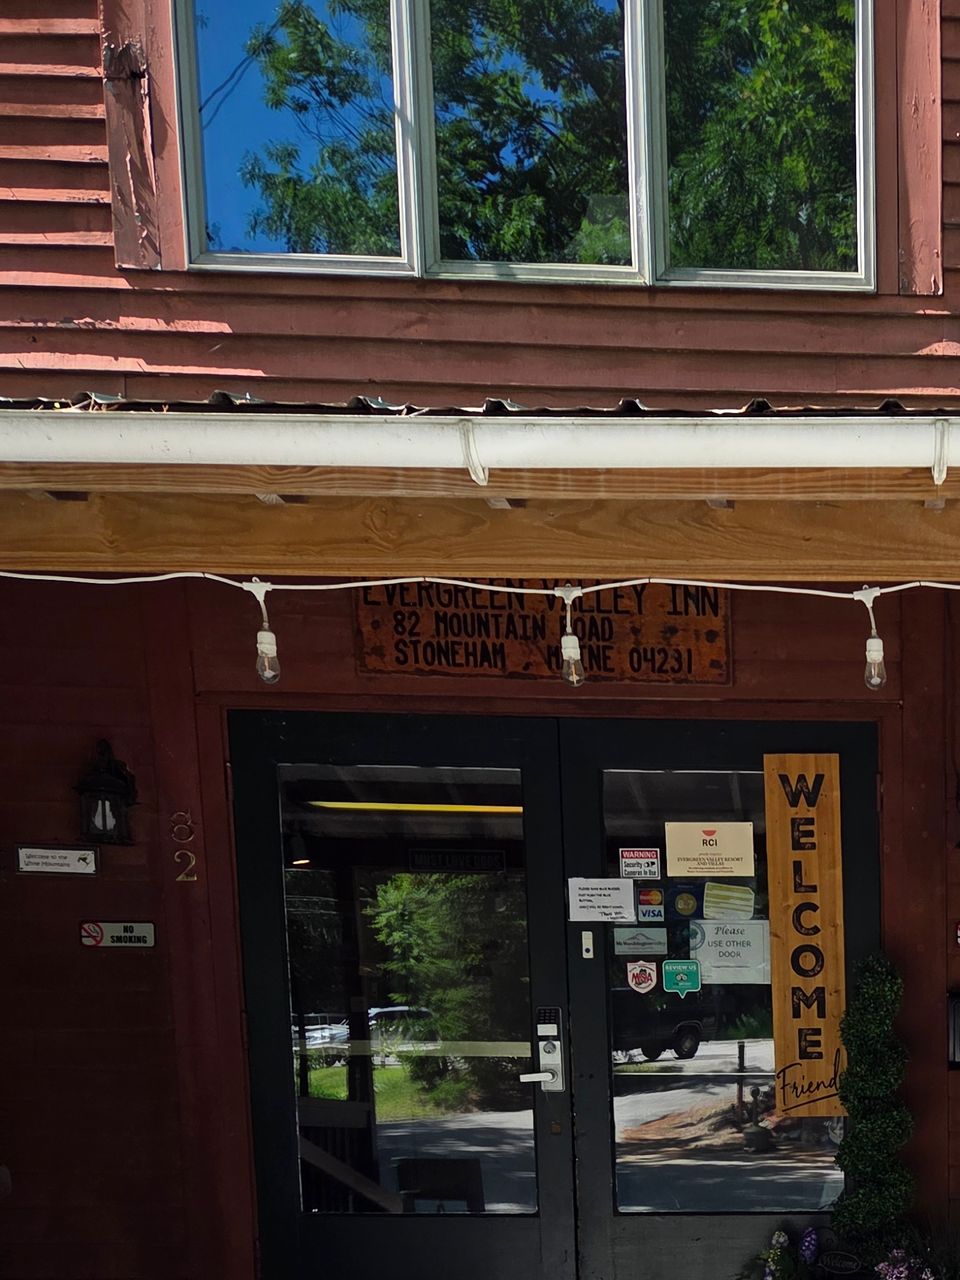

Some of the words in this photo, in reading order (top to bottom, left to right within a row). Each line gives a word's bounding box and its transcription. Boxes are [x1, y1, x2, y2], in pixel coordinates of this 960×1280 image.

[363, 578, 526, 611] EVERGREEN
[667, 584, 720, 617] INN
[393, 610, 421, 637] 82
[434, 611, 546, 641] MOUNTAIN
[393, 639, 506, 669] STONEHAM
[546, 644, 615, 672] MINE
[629, 647, 693, 674] 04231
[702, 838, 718, 847] RCI
[624, 861, 642, 869] Security
[641, 909, 663, 918] VISA
[777, 773, 827, 1061] WELCOME
[122, 925, 134, 935] NO
[714, 925, 746, 935] Please
[110, 935, 148, 944] SMOKING
[665, 964, 687, 972] REVIEW
[776, 1048, 841, 1106] Friend
